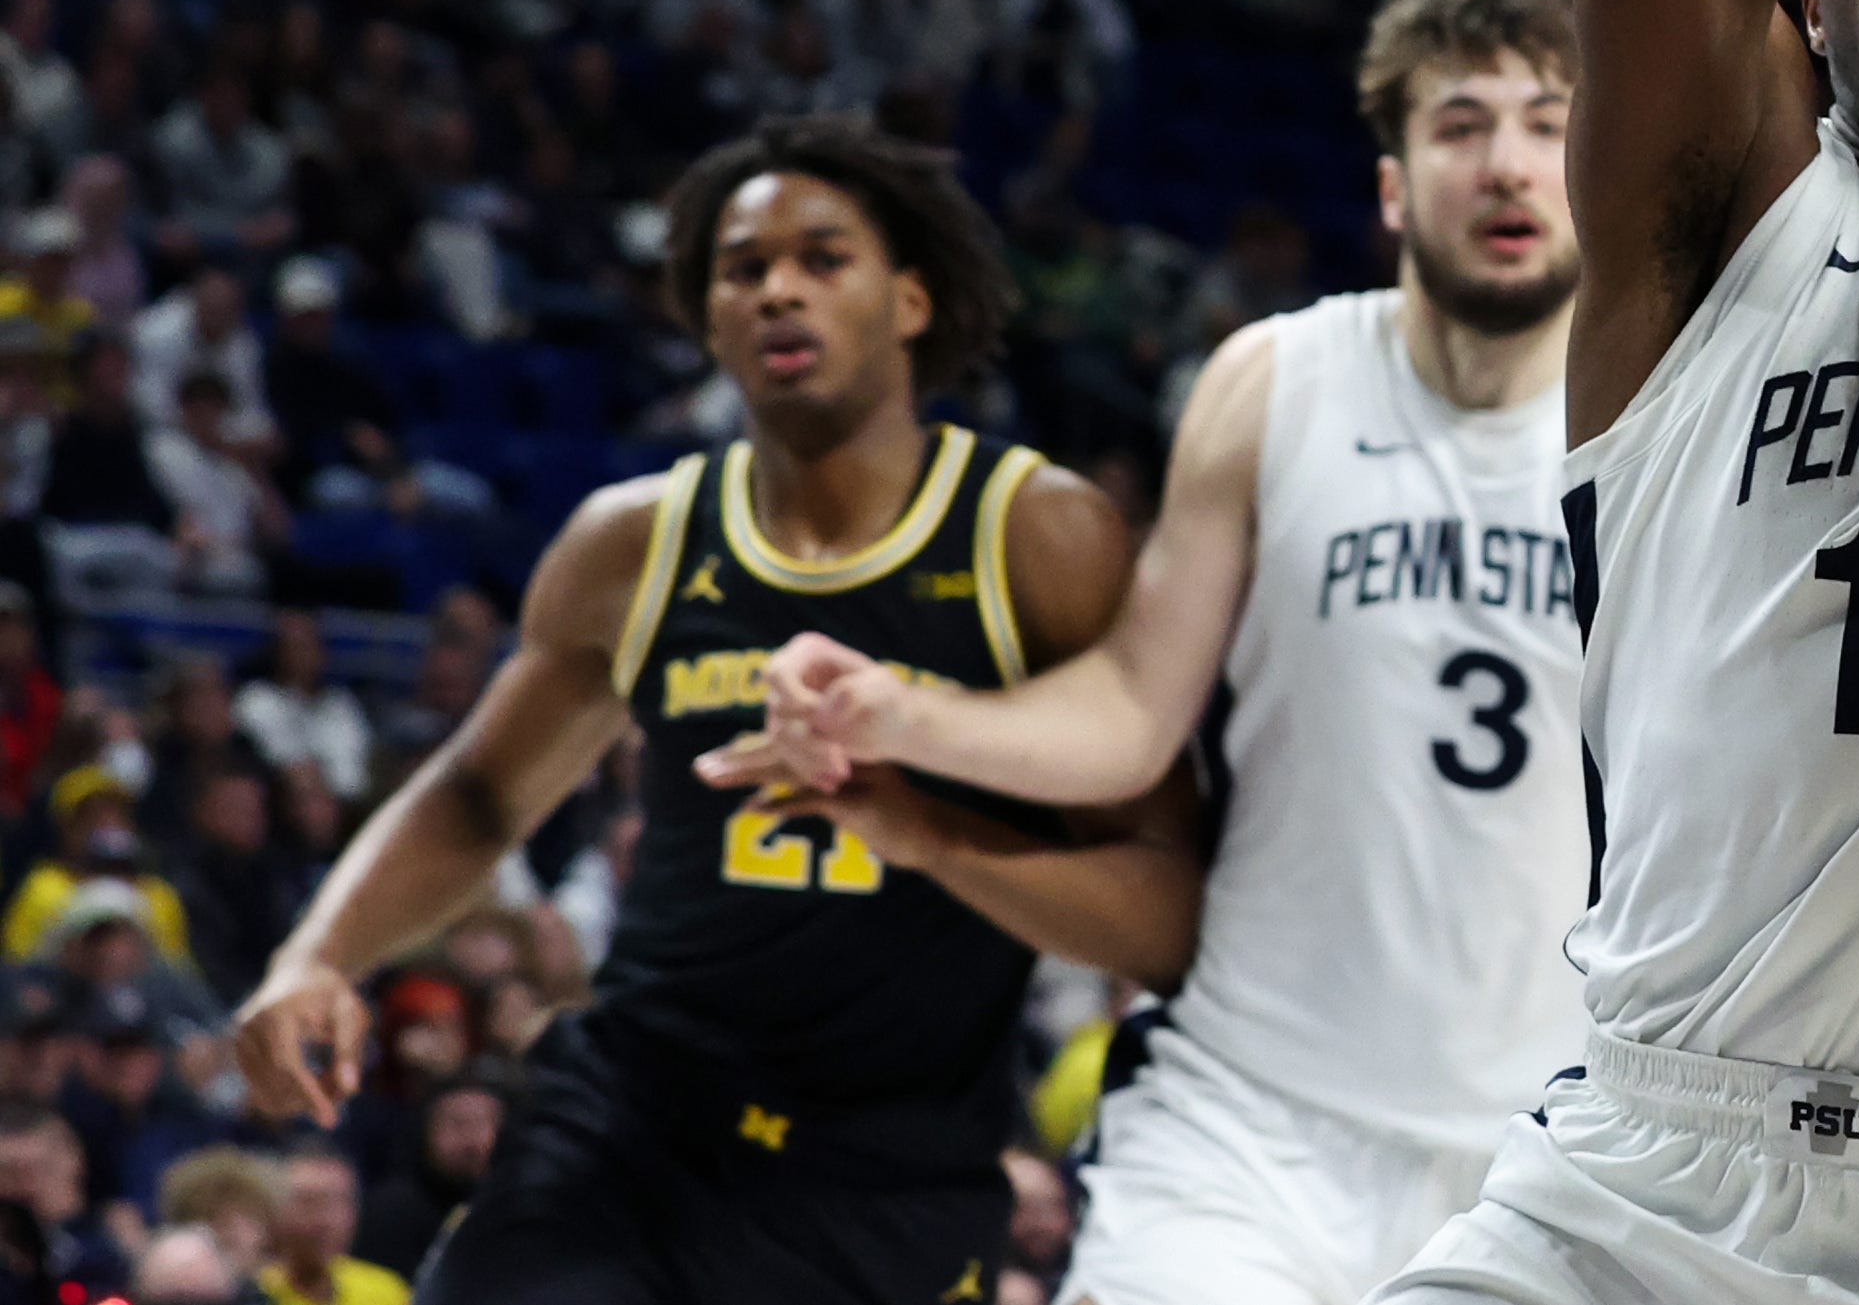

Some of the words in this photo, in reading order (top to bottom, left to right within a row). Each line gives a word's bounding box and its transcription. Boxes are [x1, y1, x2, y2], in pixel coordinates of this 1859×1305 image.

[1318, 518, 1465, 620] PENN
[1478, 526, 1577, 623] STA
[1430, 647, 1531, 792] 3
